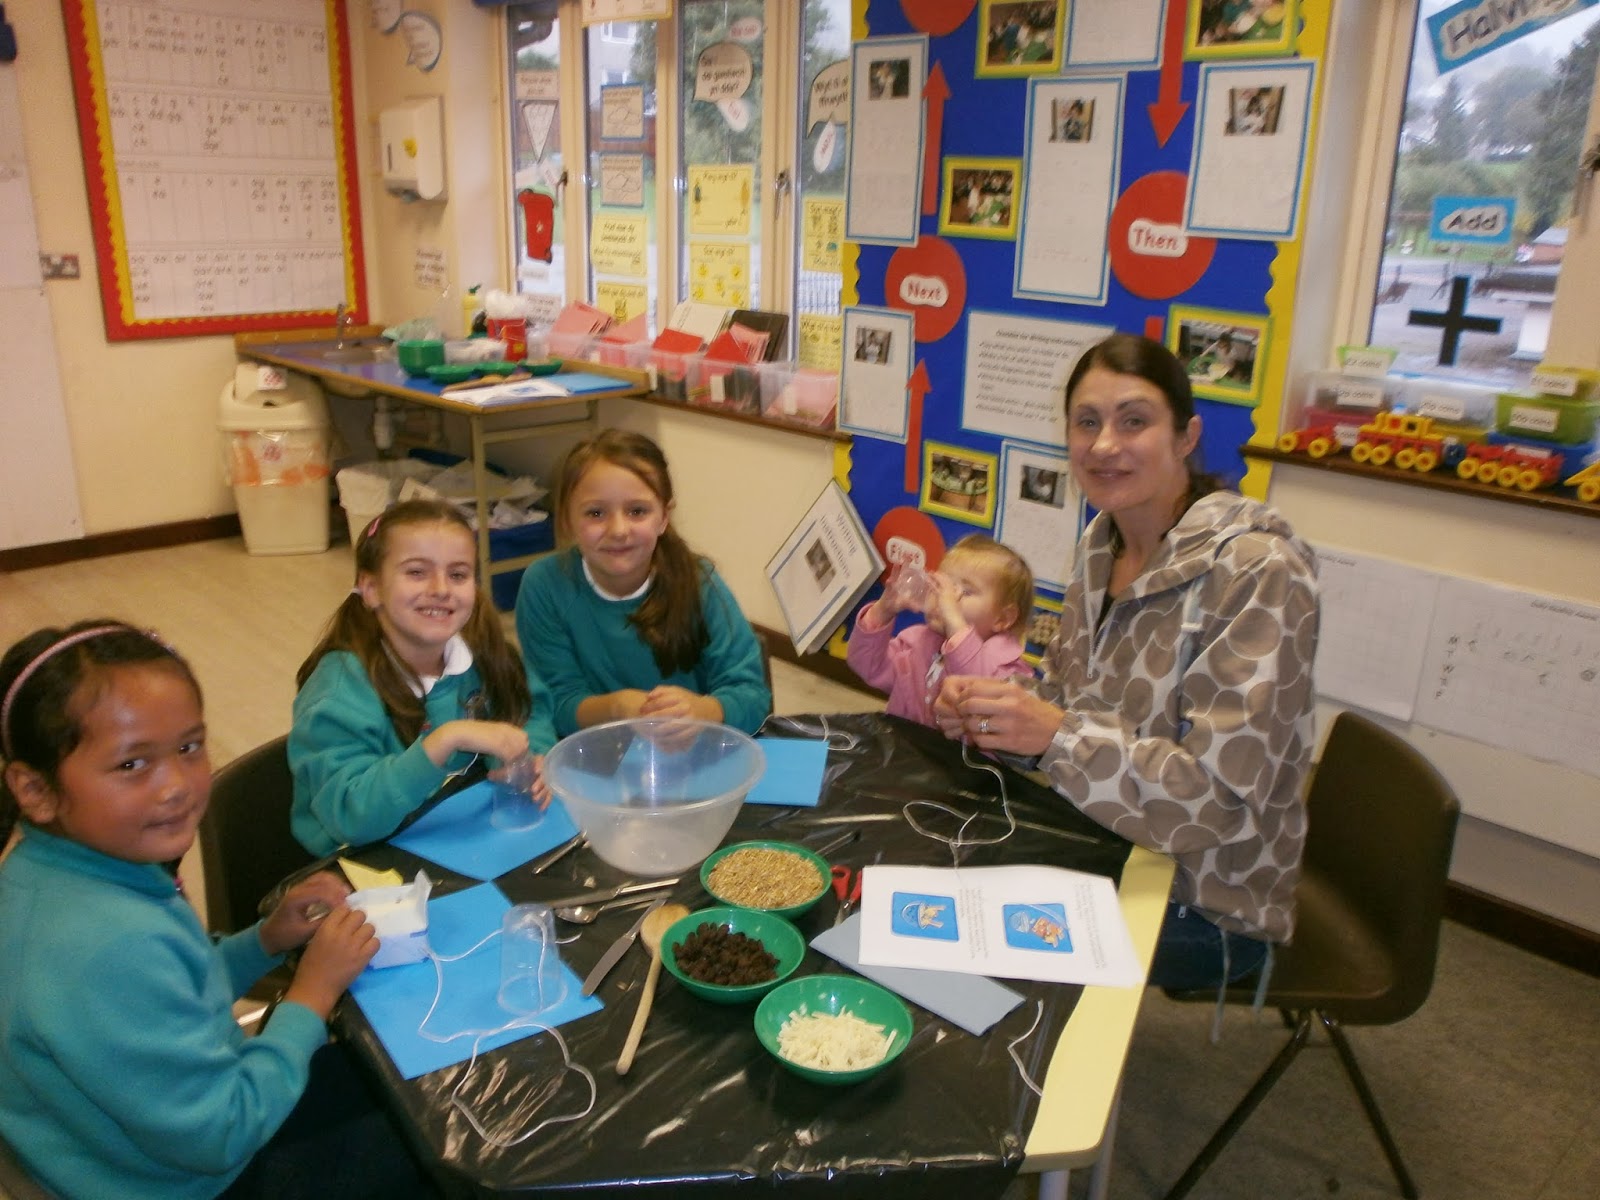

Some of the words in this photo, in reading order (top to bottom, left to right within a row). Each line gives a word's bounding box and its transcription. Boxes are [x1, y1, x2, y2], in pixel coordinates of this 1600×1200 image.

[1447, 212, 1498, 231] Add
[1133, 228, 1178, 251] Then
[907, 281, 942, 301] Next
